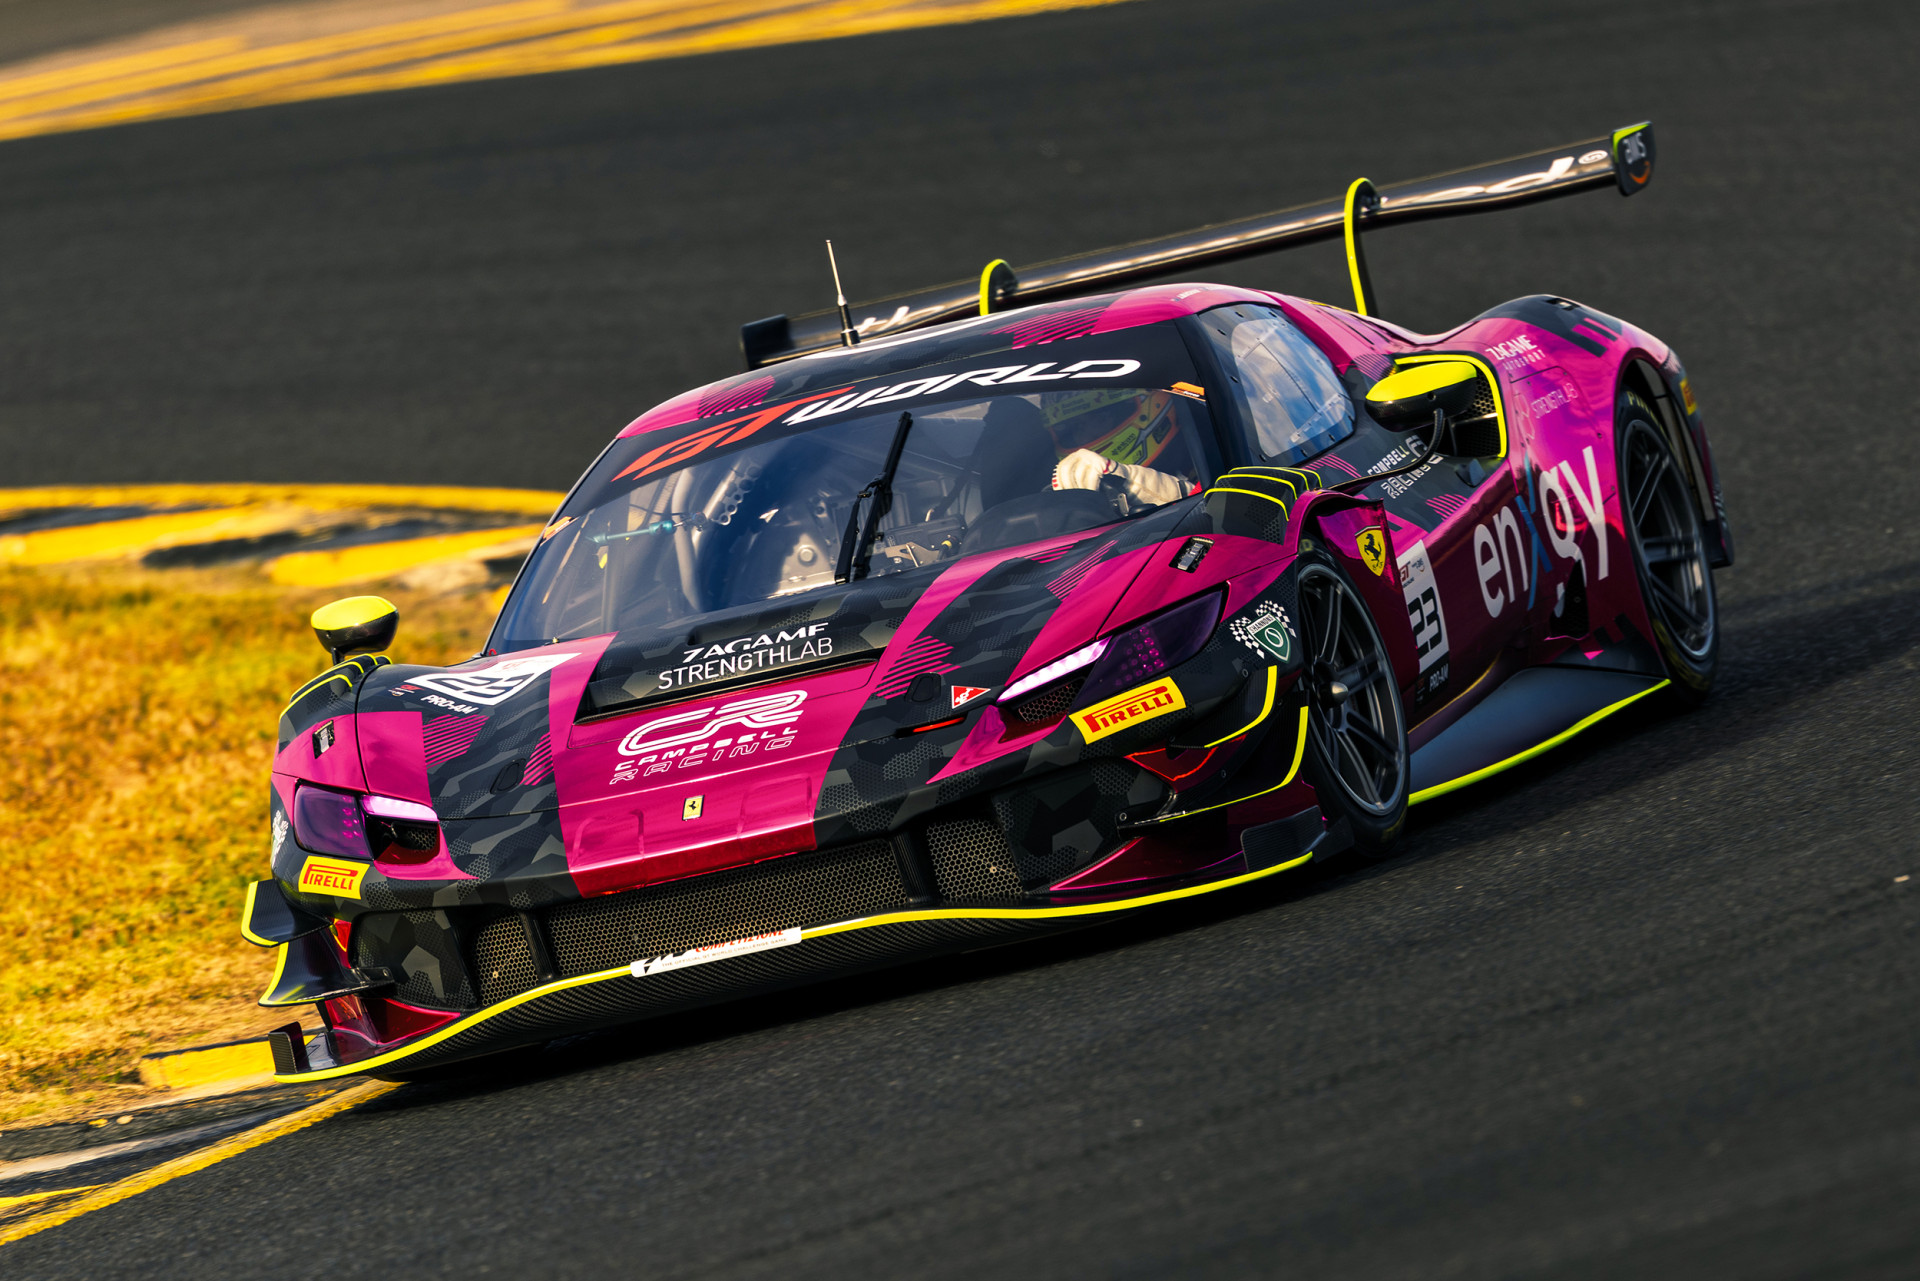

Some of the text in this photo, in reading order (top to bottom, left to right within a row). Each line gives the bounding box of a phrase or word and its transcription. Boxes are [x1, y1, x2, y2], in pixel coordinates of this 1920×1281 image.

[1485, 335, 1538, 360] ZAGAME
[1502, 349, 1546, 371] AUTOSPORT
[611, 359, 1141, 482] GT WORLD
[1247, 614, 1274, 633] SHANNONS
[1408, 586, 1442, 660] 23
[658, 637, 833, 690] STRENGTHLAB
[1428, 663, 1449, 692] PRO-AM
[421, 694, 479, 715] PRO-AM
[1082, 685, 1174, 733] PIRELLI
[609, 735, 795, 785] RACING
[614, 727, 798, 771] CAMPBELL
[303, 863, 359, 890] PIRELLI
